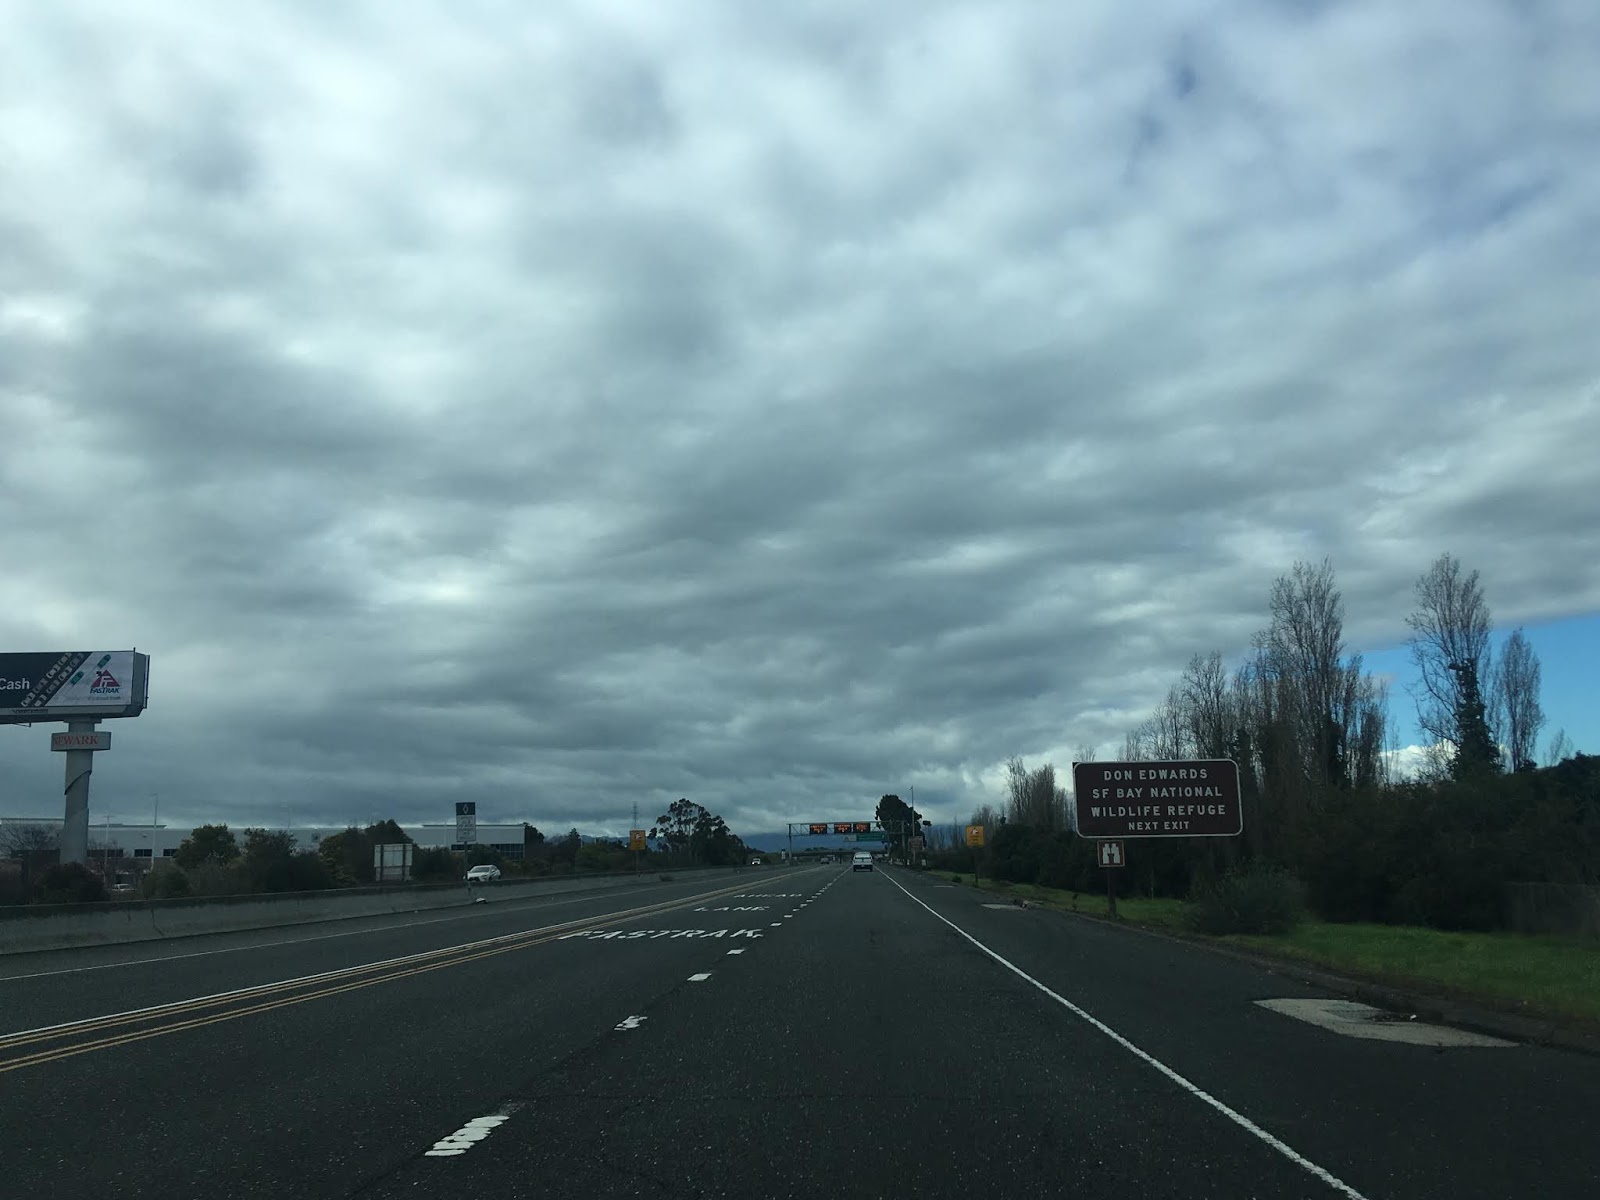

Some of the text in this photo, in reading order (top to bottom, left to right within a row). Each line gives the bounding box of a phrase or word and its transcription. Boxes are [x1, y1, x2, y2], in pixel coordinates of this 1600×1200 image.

[0, 678, 30, 690] Cash
[1104, 769, 1208, 781] DON EDWARDS
[1092, 786, 1222, 799] SF BAY NATIONAL
[1091, 805, 1226, 817] WILDLIFE REFUGE
[1128, 821, 1190, 830] NEXT EXIT
[557, 929, 764, 940] FASTRAK
